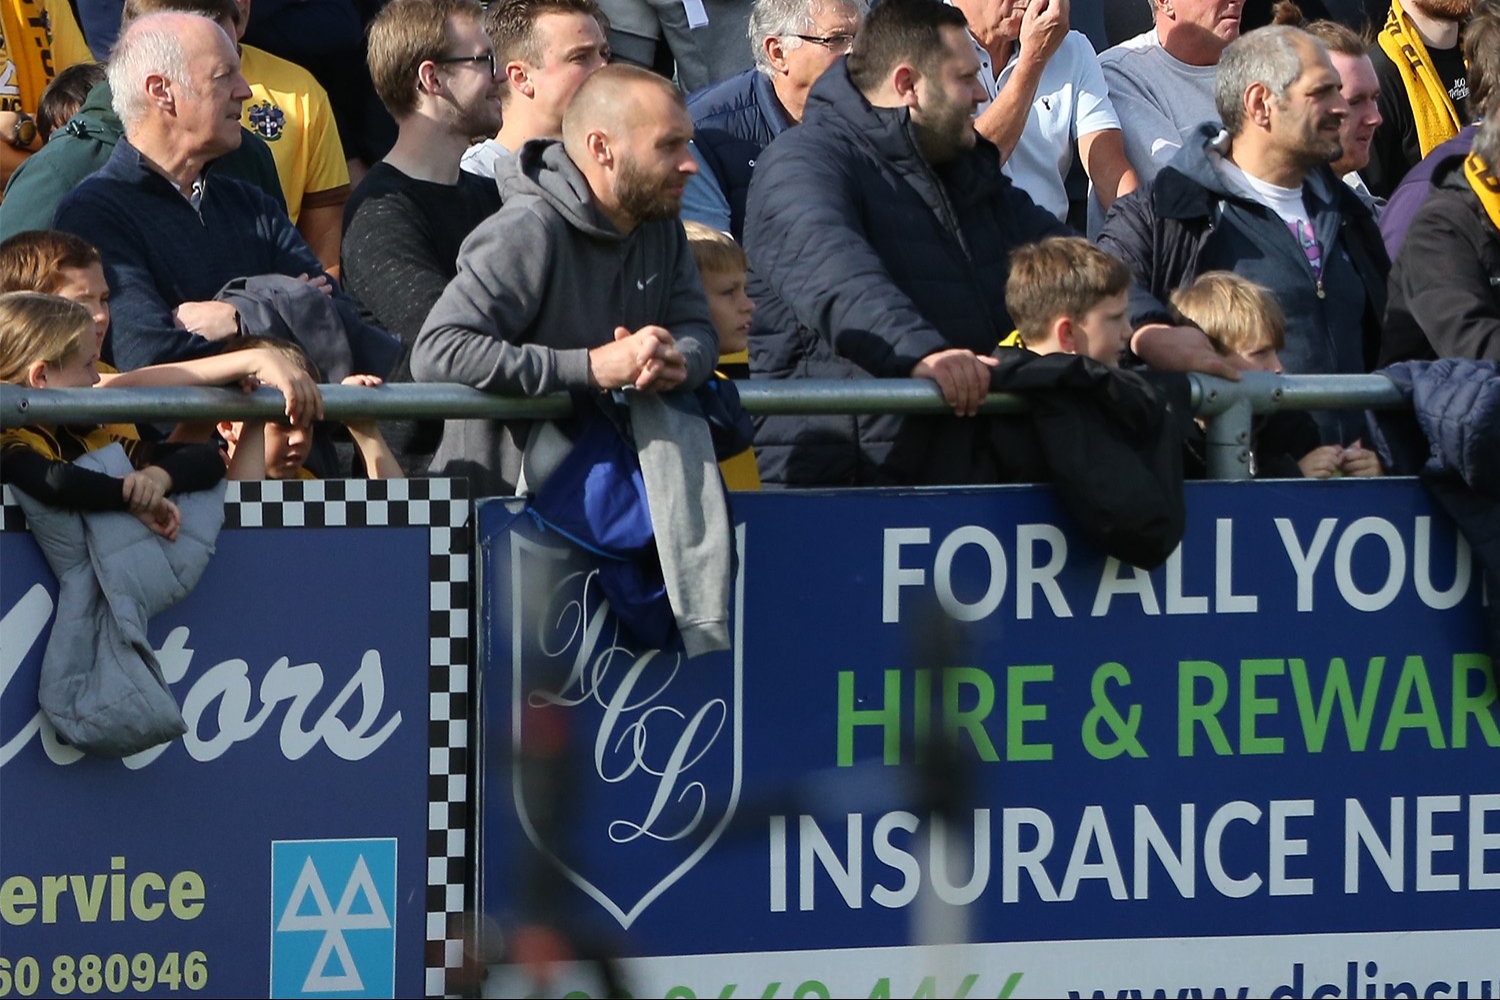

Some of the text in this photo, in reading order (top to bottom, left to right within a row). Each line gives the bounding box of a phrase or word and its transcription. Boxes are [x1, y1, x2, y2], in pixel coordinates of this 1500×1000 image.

[882, 524, 1073, 624] FOR
[1090, 518, 1258, 617] ALL
[837, 665, 1054, 767] HIRE
[1081, 661, 1149, 760] &
[0, 856, 206, 926] ervice
[769, 799, 1315, 912] INSURANCE
[51, 951, 208, 995] 880946
